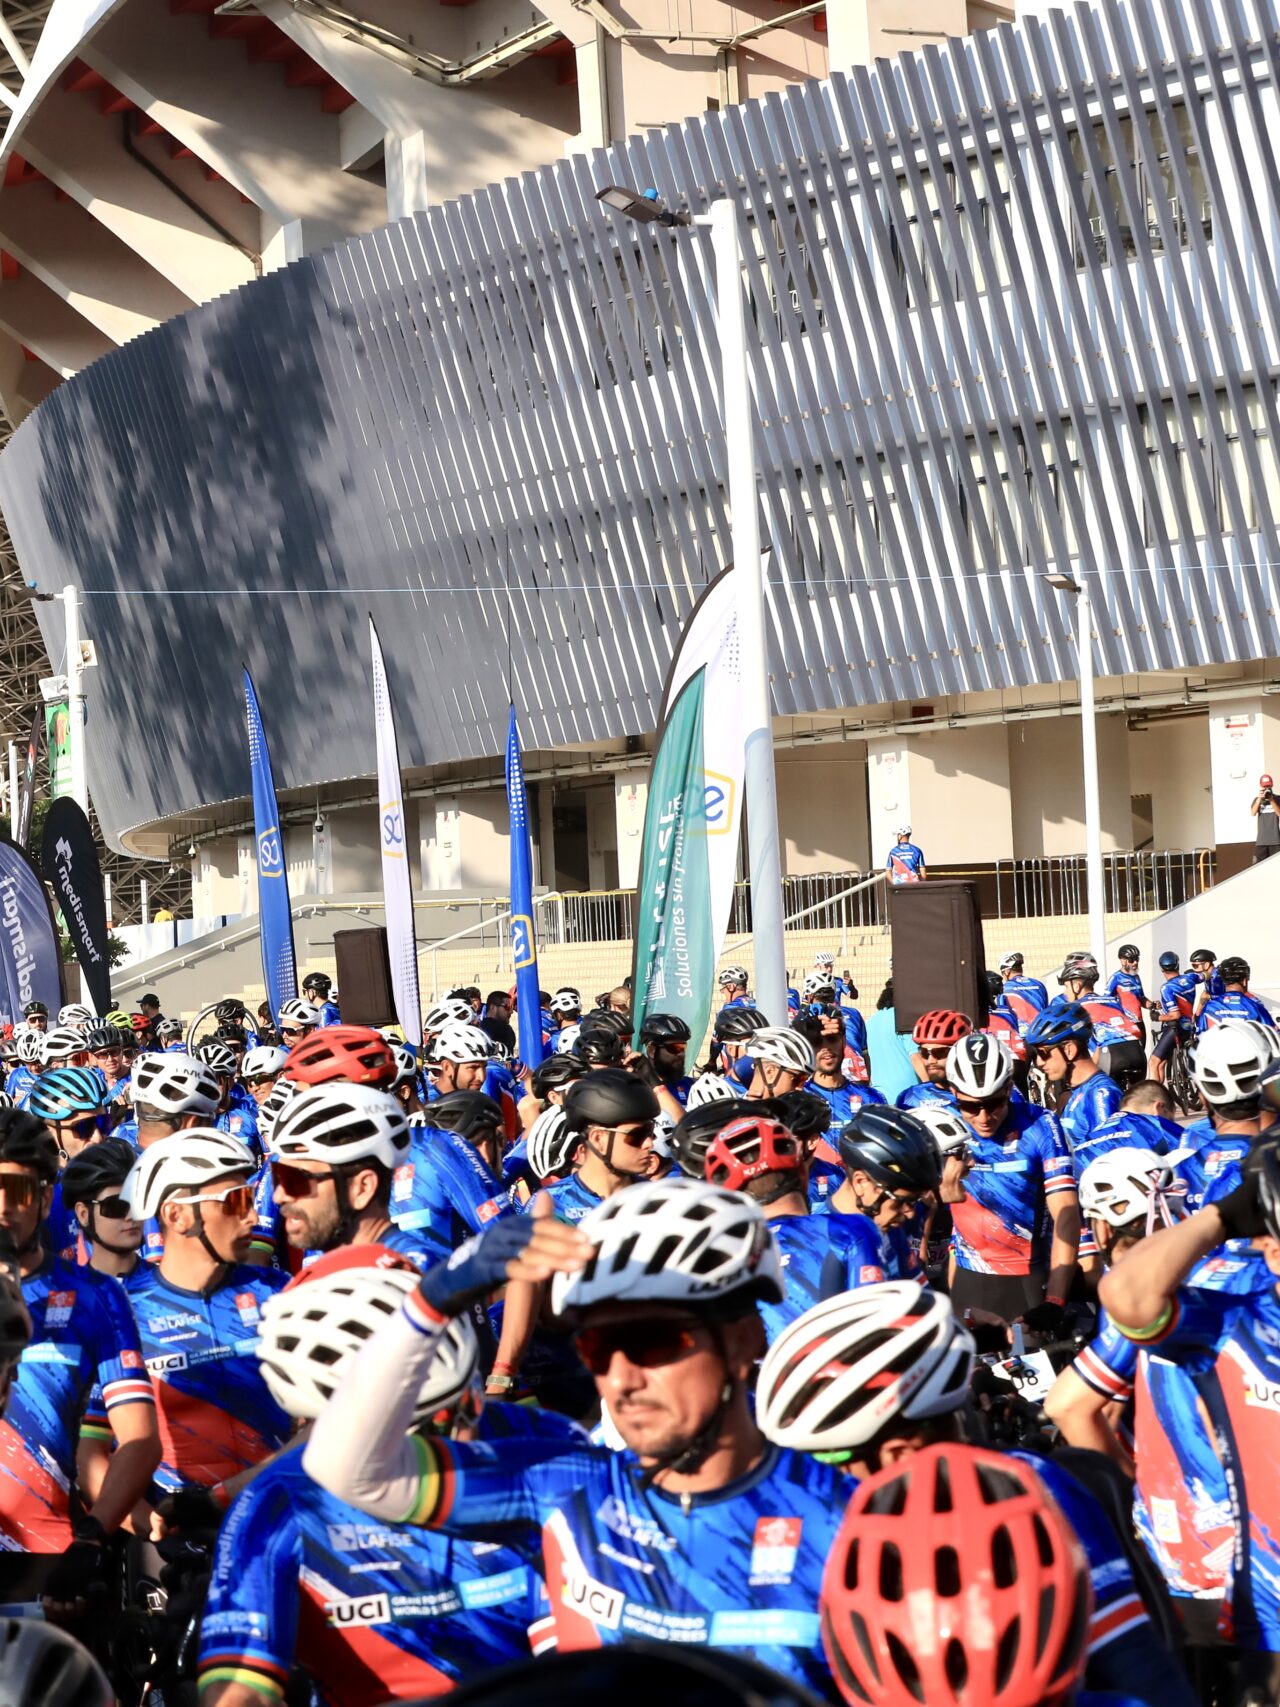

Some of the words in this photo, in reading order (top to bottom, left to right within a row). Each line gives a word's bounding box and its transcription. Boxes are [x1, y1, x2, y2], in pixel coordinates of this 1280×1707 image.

[58, 866, 102, 964] medismart
[671, 906, 693, 998] Soluciones
[451, 1129, 493, 1185] medismart
[167, 1314, 202, 1329] LAFISE
[153, 1355, 185, 1371] UCI
[358, 1532, 413, 1549] LAFISE
[336, 1601, 384, 1622] UCI
[571, 1577, 615, 1619] UCI
